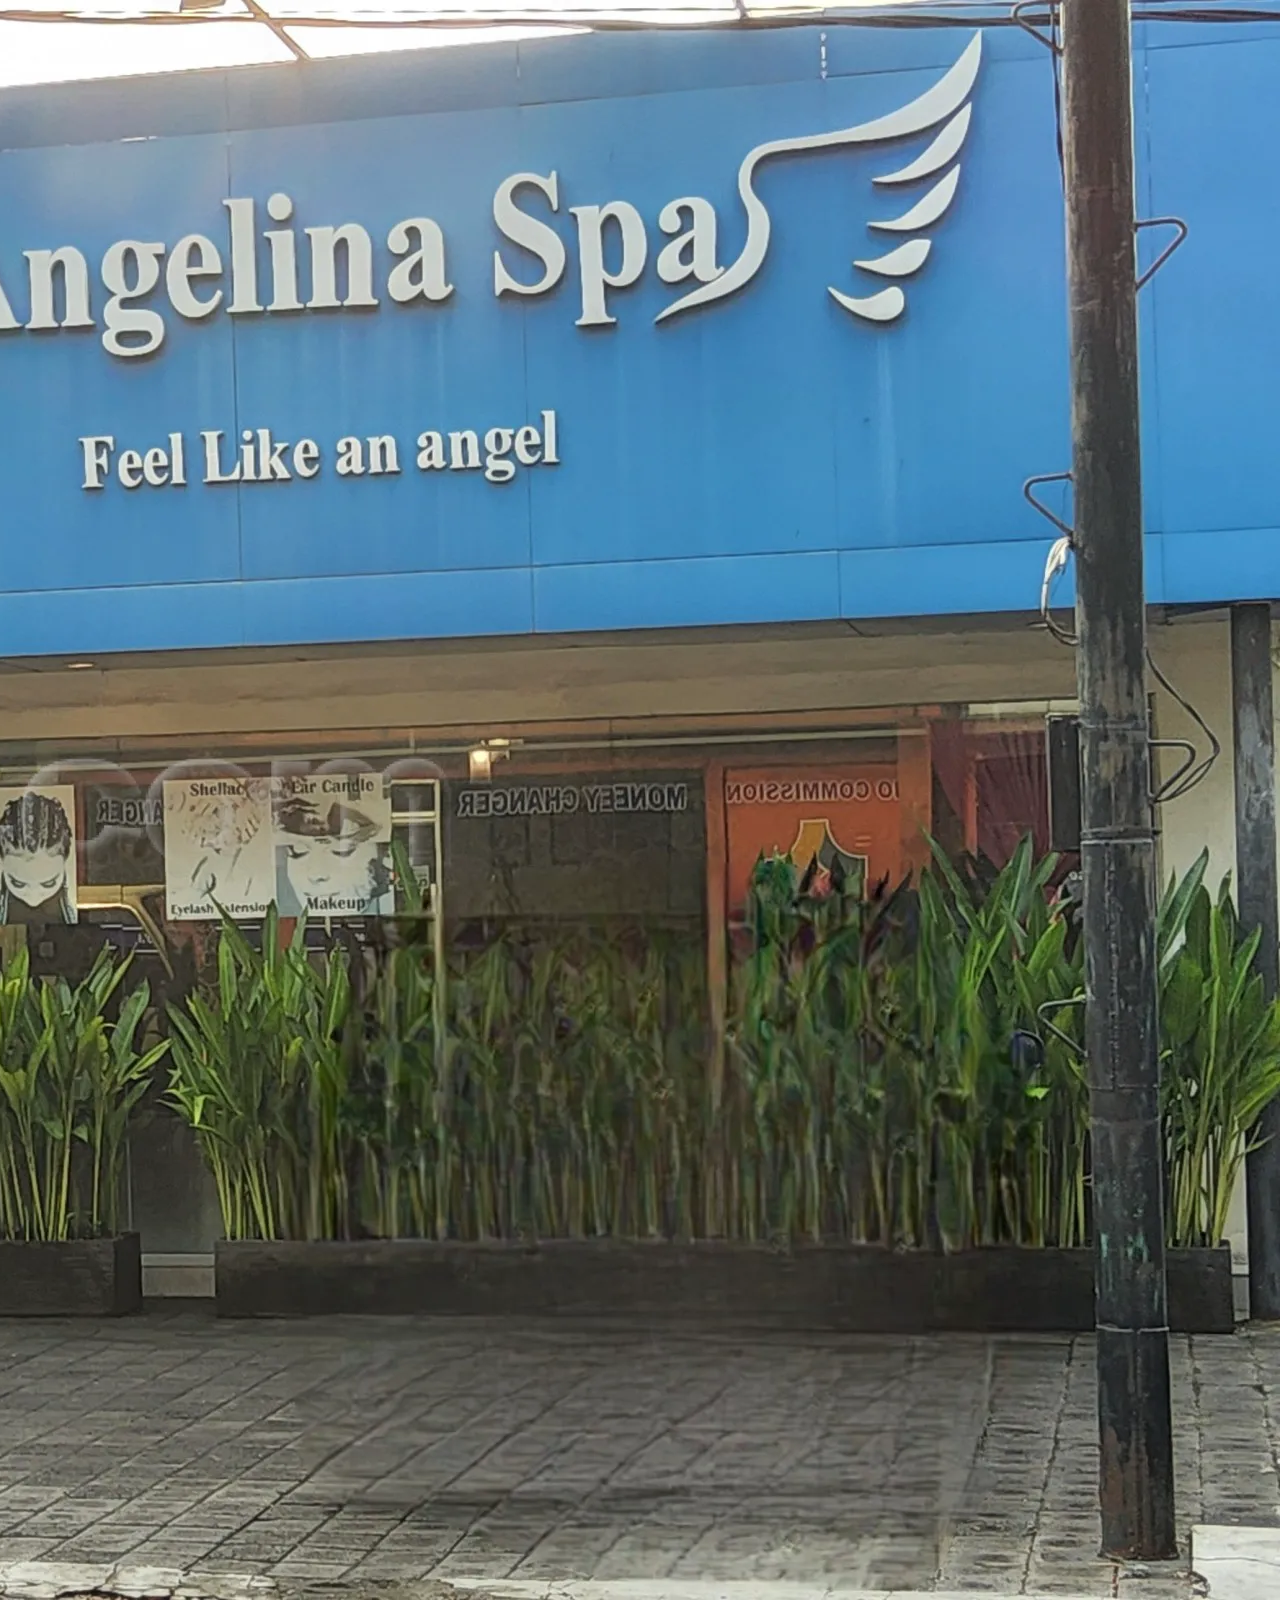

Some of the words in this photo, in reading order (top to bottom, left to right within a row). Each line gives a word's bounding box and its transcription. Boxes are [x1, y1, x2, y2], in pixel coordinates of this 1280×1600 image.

[494, 170, 725, 325] Spa
[78, 432, 188, 488] Feel
[201, 428, 320, 484] Like
[336, 433, 401, 476] an
[417, 410, 560, 484] angel
[190, 782, 246, 797] Shellac
[291, 779, 317, 794] Ear
[322, 777, 375, 793] Candle
[170, 903, 214, 915] Eyelash
[306, 897, 366, 911] Makeup
